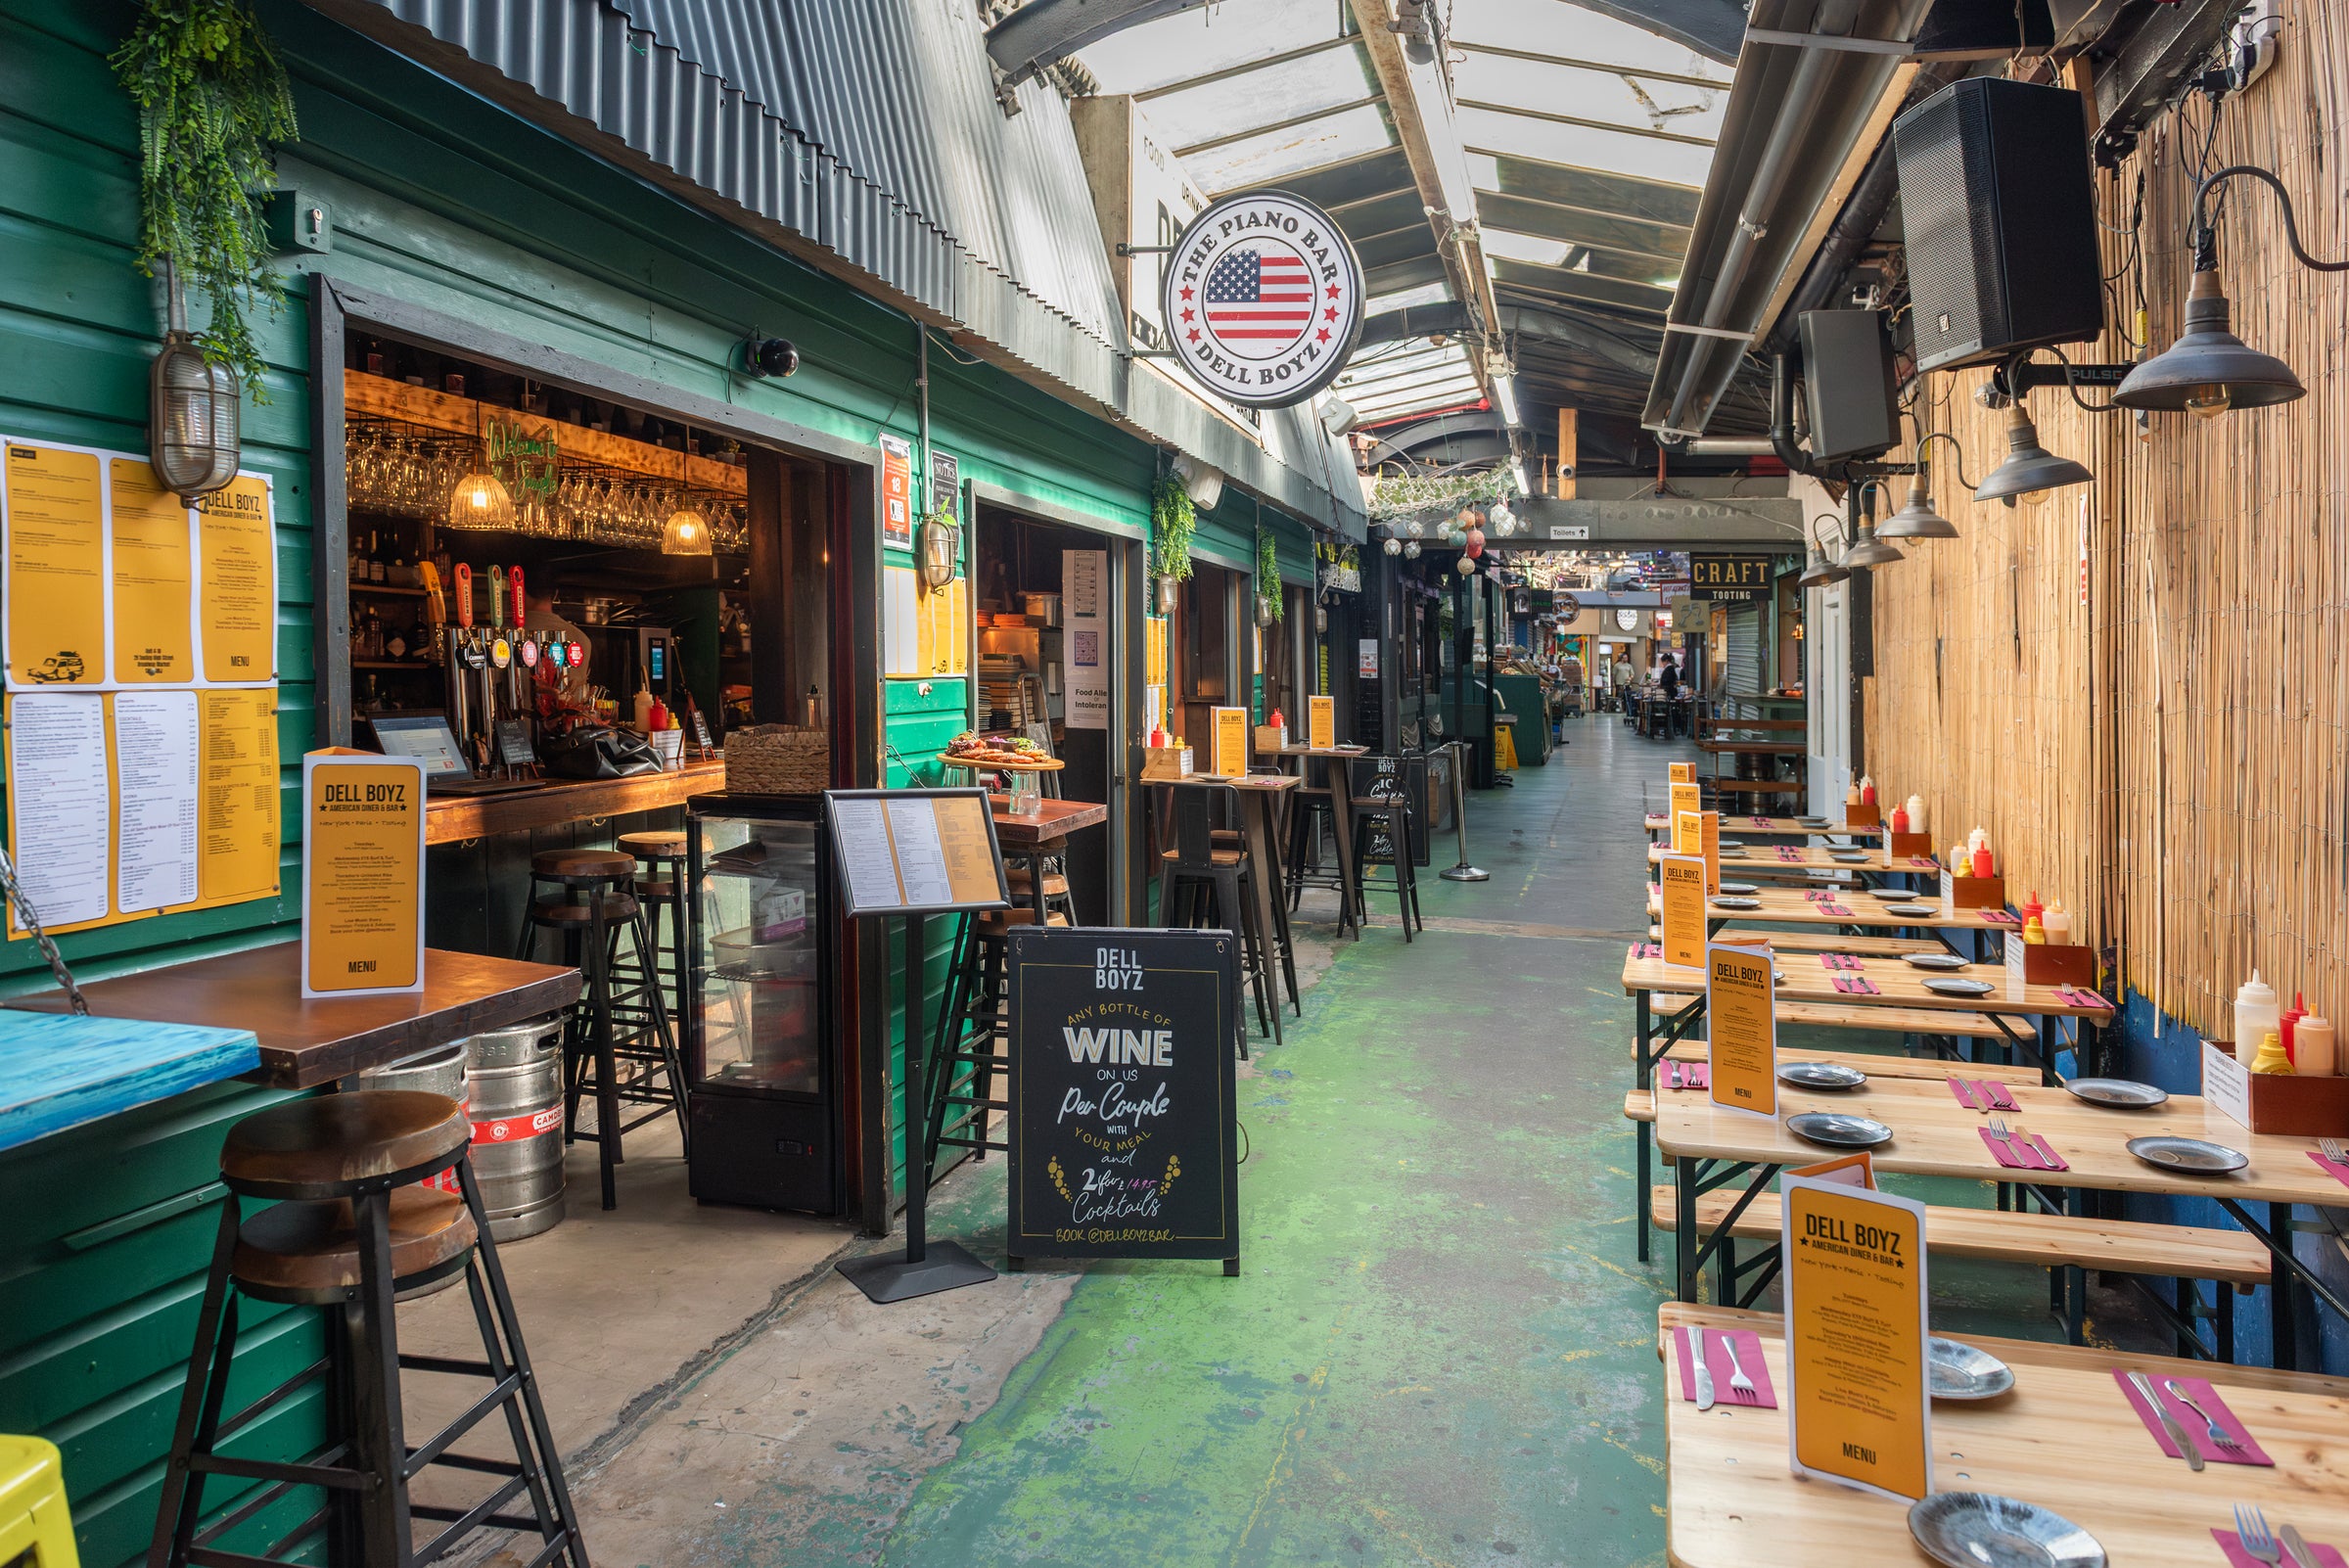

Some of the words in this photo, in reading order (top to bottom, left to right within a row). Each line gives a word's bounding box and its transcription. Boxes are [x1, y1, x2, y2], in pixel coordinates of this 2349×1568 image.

[1143, 134, 1165, 172] FOOD
[1182, 234, 1218, 284] THE
[1219, 210, 1299, 238] PIANO
[1301, 229, 1338, 283] BAR
[1195, 343, 1252, 385] DELL
[1260, 343, 1320, 385] BOYZ
[892, 477, 900, 493] 18
[208, 490, 233, 509] DELL
[237, 493, 260, 512] BOYZ
[1553, 529, 1576, 537] Toilets
[1693, 562, 1769, 583] CRAFT
[1712, 590, 1751, 600] TOOTING
[231, 656, 250, 667] MENU
[325, 784, 362, 803] DELL
[366, 784, 405, 803] BOYZ
[329, 804, 360, 812] AMERICAN
[361, 804, 380, 812] DINER
[386, 804, 398, 812] BAR
[1668, 868, 1682, 878] DELL
[1683, 869, 1698, 879] BOYZ
[348, 960, 377, 974] MENU
[1096, 947, 1142, 969] DELL
[1095, 970, 1143, 991] BOYZ
[1718, 963, 1738, 978] DELL
[1741, 967, 1763, 983] BOYZ
[1068, 1005, 1092, 1026] ANY
[1099, 1003, 1151, 1020] BOTTLE
[1154, 1014, 1172, 1027] OF
[1063, 1027, 1174, 1067] WINE
[1097, 1069, 1115, 1081] ON
[1123, 1069, 1138, 1081] US
[1734, 1087, 1752, 1099] MENU
[1057, 1086, 1097, 1125] Per
[1099, 1081, 1171, 1128] Couple
[1075, 1127, 1111, 1152] YOUR
[1117, 1130, 1152, 1152] MEAL
[1106, 1125, 1128, 1135] WITH
[1101, 1148, 1136, 1167] and
[1082, 1168, 1098, 1191] 2
[1097, 1169, 1121, 1196] for
[1073, 1188, 1161, 1223] Cocktails
[1056, 1228, 1085, 1243] BOOK
[1806, 1213, 1853, 1245] DELL
[1856, 1223, 1901, 1257] BOYZ
[1811, 1238, 1849, 1256] AMERICAN
[1850, 1248, 1871, 1261] DINER
[1879, 1255, 1895, 1267] BAR
[1842, 1442, 1876, 1465] MENU
